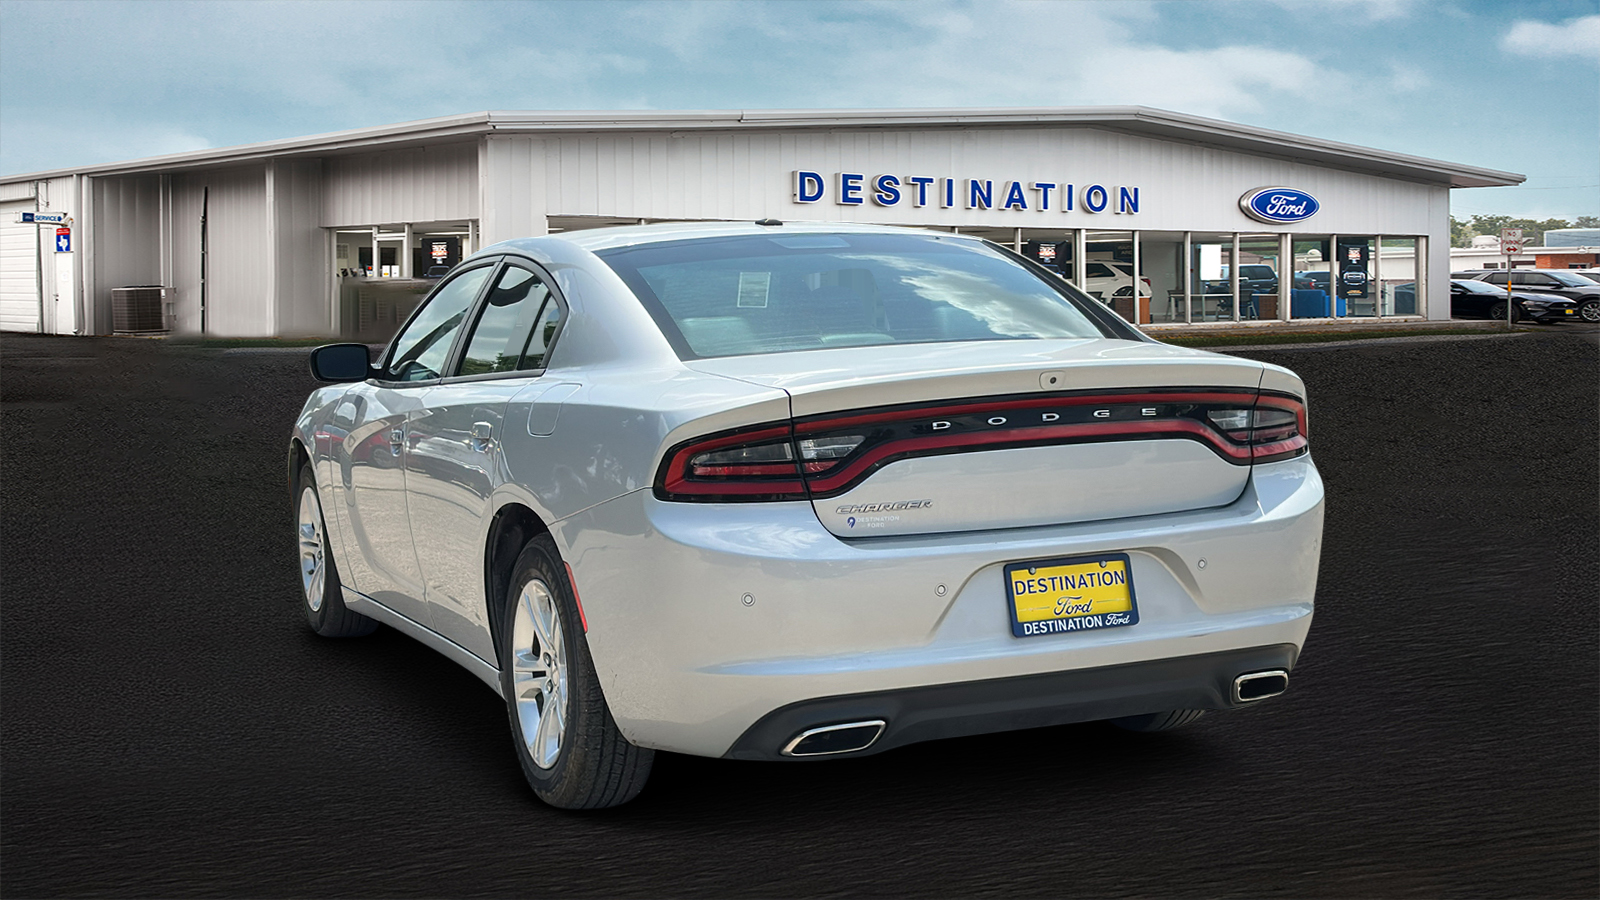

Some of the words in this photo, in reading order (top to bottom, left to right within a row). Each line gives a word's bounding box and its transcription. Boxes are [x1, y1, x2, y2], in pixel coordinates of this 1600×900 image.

[795, 170, 1140, 214] DESTINATION
[1266, 195, 1306, 215] Ford
[35, 214, 58, 222] SERVICE
[931, 407, 1157, 431] DODGE
[836, 499, 933, 514] CHARGER
[857, 515, 900, 523] DESTINATION
[1014, 570, 1125, 595] DESTINATION
[1053, 596, 1093, 616] Ford
[1023, 615, 1103, 635] DESTINATION
[1105, 613, 1131, 626] Ford
